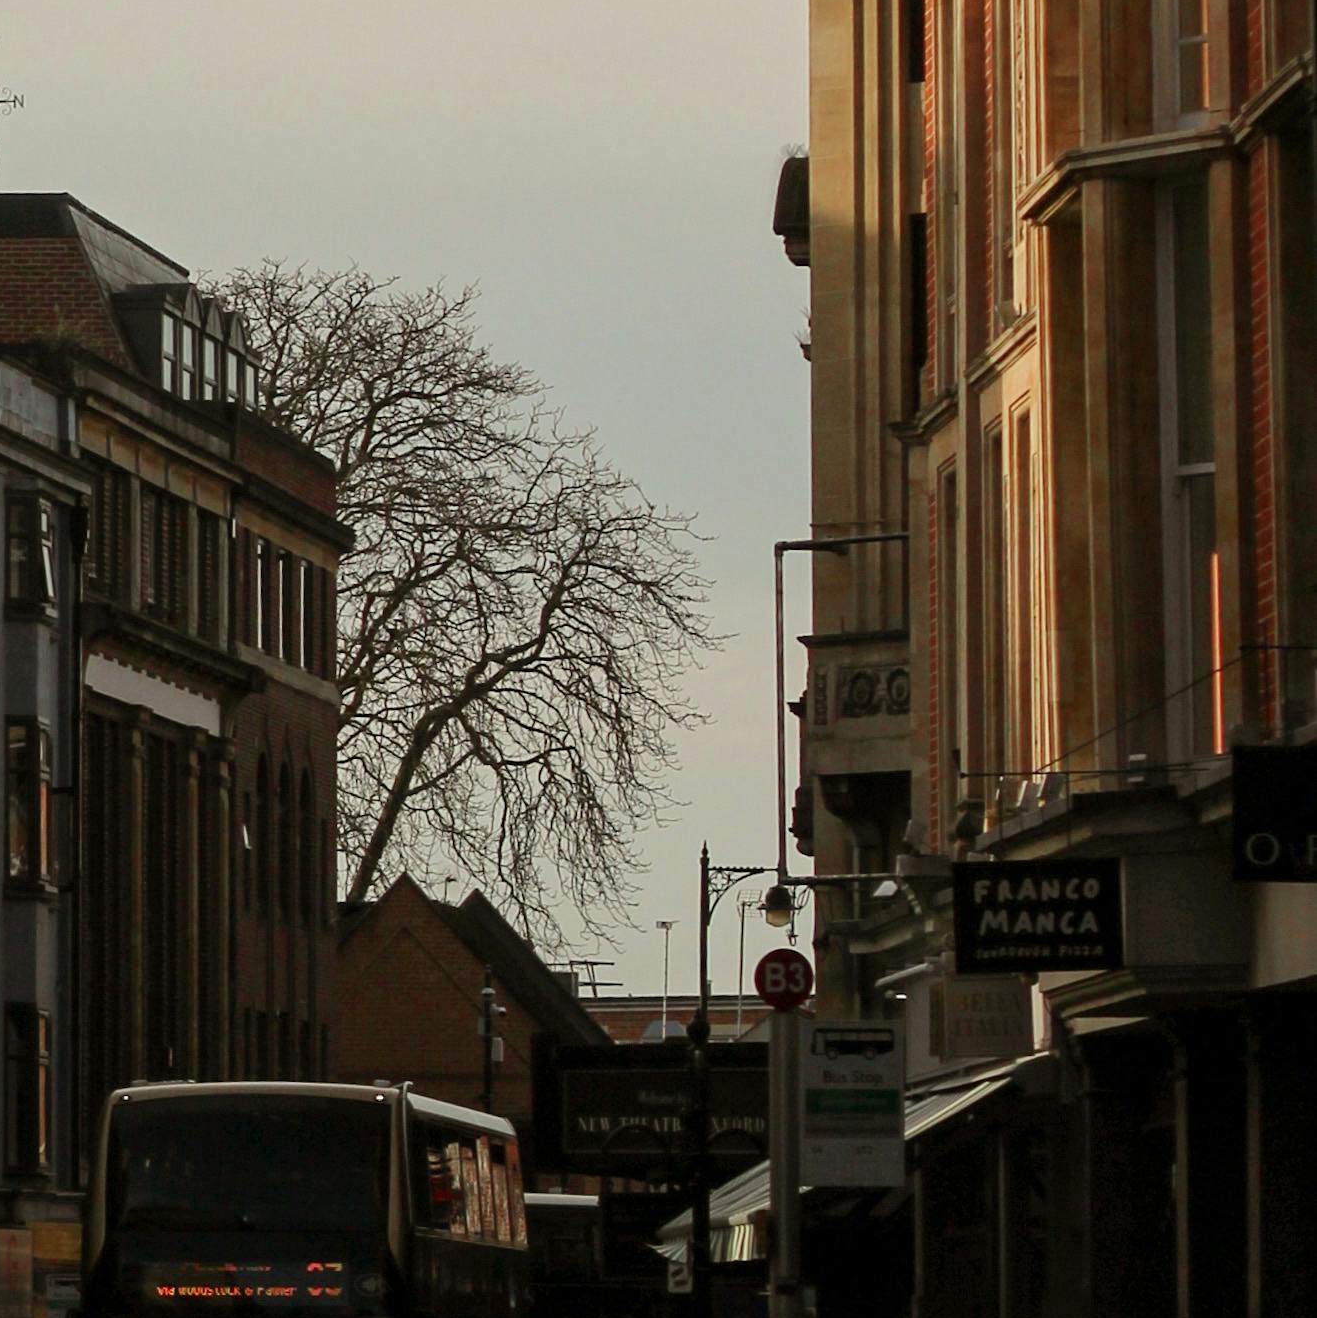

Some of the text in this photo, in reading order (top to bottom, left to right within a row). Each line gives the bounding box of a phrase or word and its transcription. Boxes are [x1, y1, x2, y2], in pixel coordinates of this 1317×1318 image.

[972, 877, 1101, 904] FRANCO
[979, 908, 1099, 937] MANCA
[1057, 944, 1104, 959] PIZZA
[764, 962, 806, 993] B3
[822, 1071, 882, 1086] Bus Stop
[578, 1115, 766, 1132] NEW THEATR XFORD
